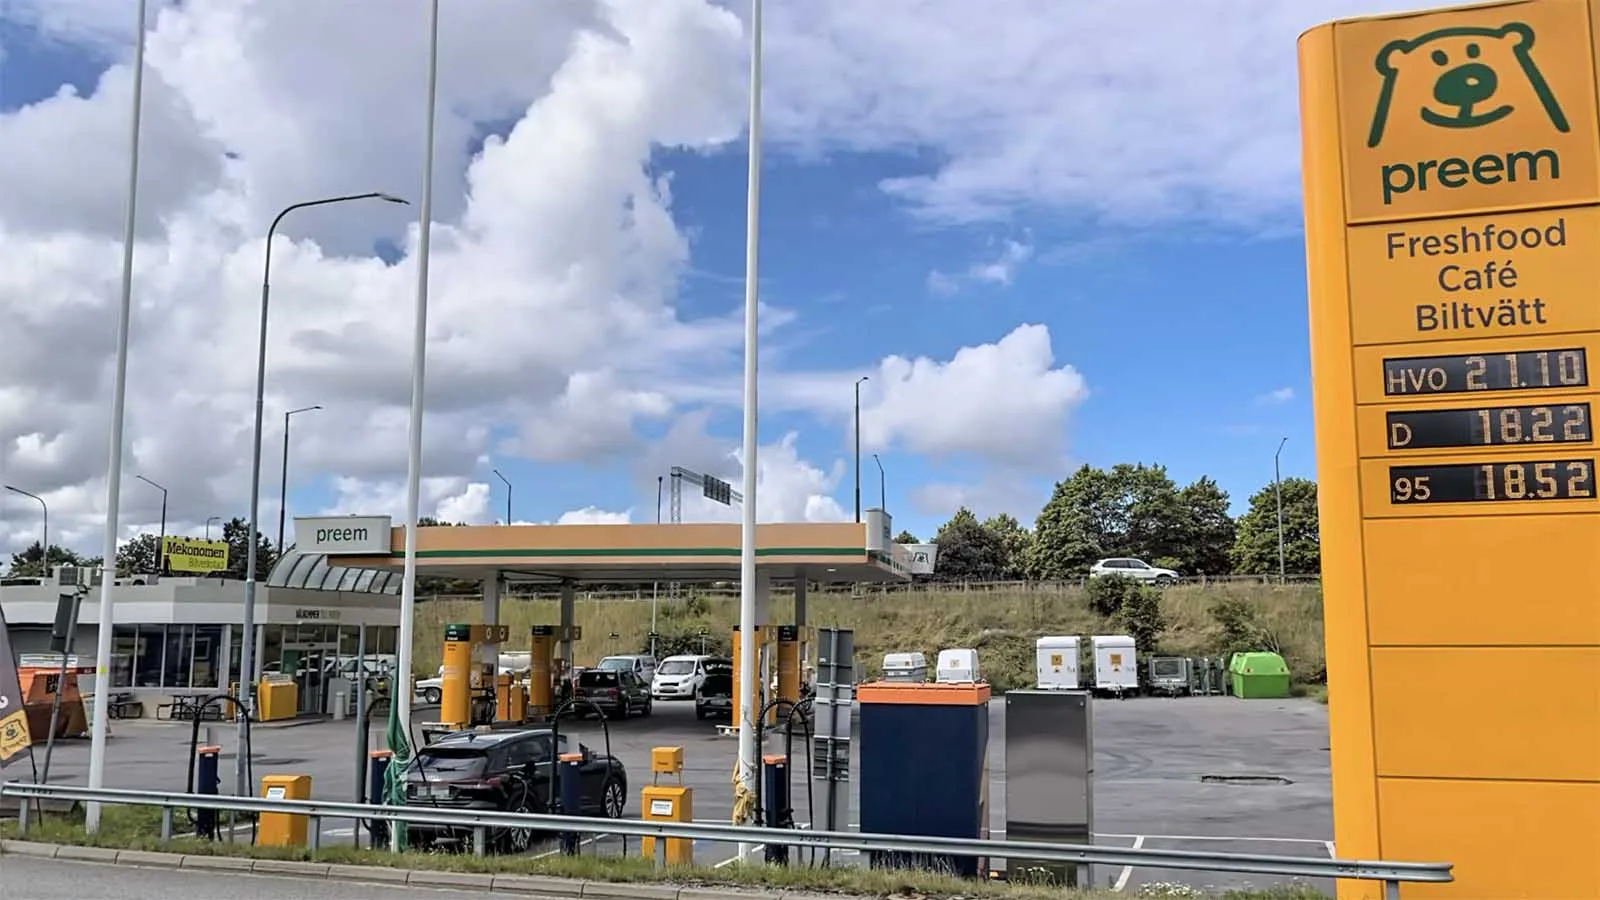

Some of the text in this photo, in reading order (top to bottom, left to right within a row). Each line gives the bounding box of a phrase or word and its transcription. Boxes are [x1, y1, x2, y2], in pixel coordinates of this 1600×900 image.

[1381, 149, 1560, 205] preem
[1386, 218, 1567, 259] Freshfood
[1438, 260, 1518, 292] Café
[1416, 298, 1547, 331] Biltvätt
[1388, 367, 1448, 393] HVO
[1391, 405, 1586, 447] D 18.22
[1394, 461, 1591, 501] 95 18.52
[166, 541, 225, 559] Mekonomen
[316, 527, 368, 545] preem
